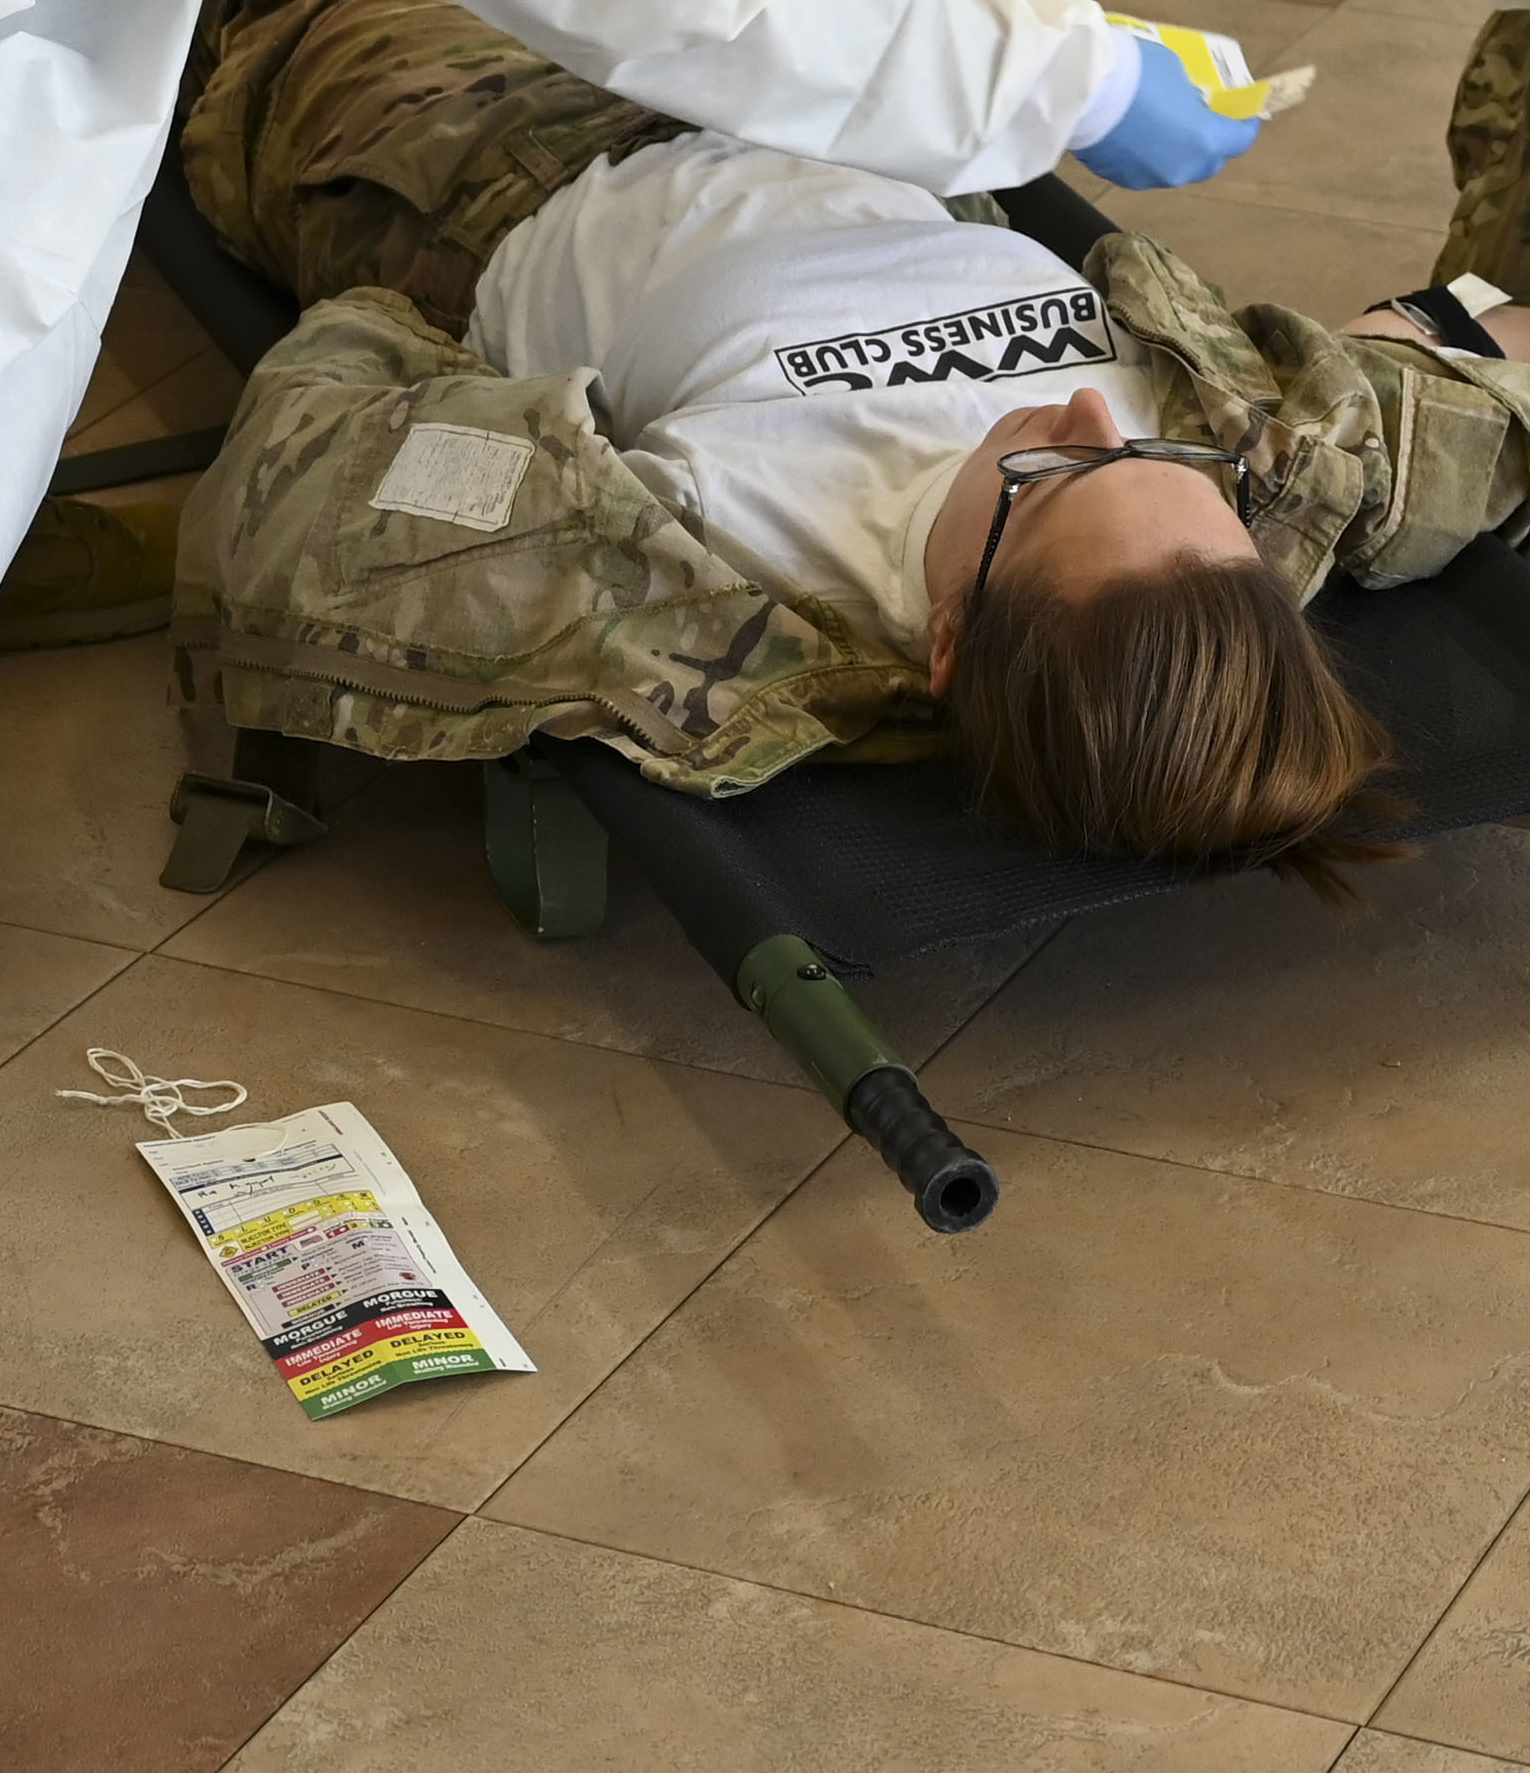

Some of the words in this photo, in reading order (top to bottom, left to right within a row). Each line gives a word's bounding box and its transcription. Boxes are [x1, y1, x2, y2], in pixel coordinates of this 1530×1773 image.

[901, 292, 1096, 357] BUSINESS
[787, 338, 891, 377] CLUB
[231, 1246, 287, 1273] START
[363, 1288, 438, 1309] MORGUE
[273, 1310, 348, 1346] MORGUE
[375, 1310, 453, 1329] IMMEDIATE
[285, 1328, 363, 1367] IMMEDIATE
[390, 1331, 466, 1348] DELAYED
[299, 1349, 374, 1386] DELAYED
[412, 1354, 475, 1370] MINOR
[320, 1374, 383, 1406] MINOR
